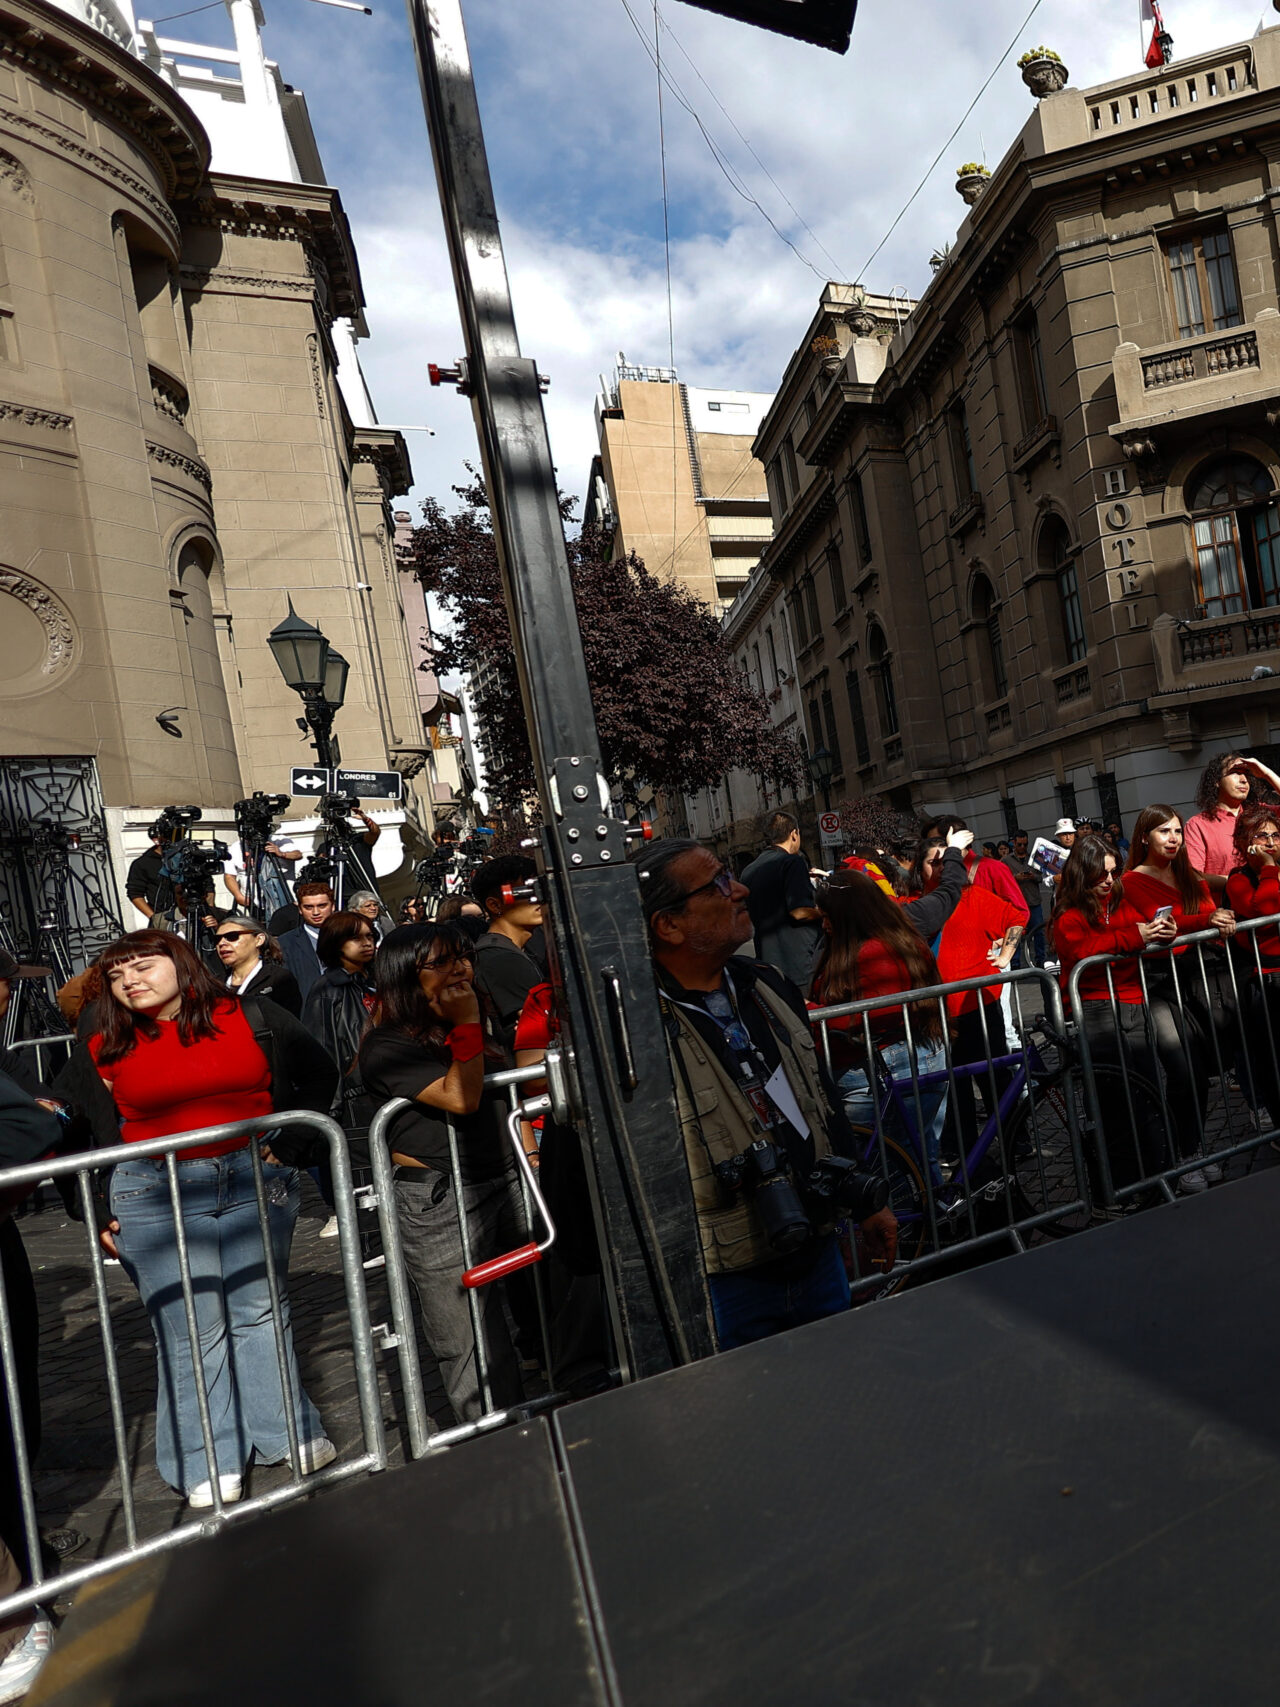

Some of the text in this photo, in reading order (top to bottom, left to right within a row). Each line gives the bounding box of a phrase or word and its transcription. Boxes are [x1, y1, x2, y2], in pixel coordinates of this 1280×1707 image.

[1103, 468, 1148, 630] HOTEL
[339, 773, 377, 781] LONDRES
[388, 791, 397, 799] 61
